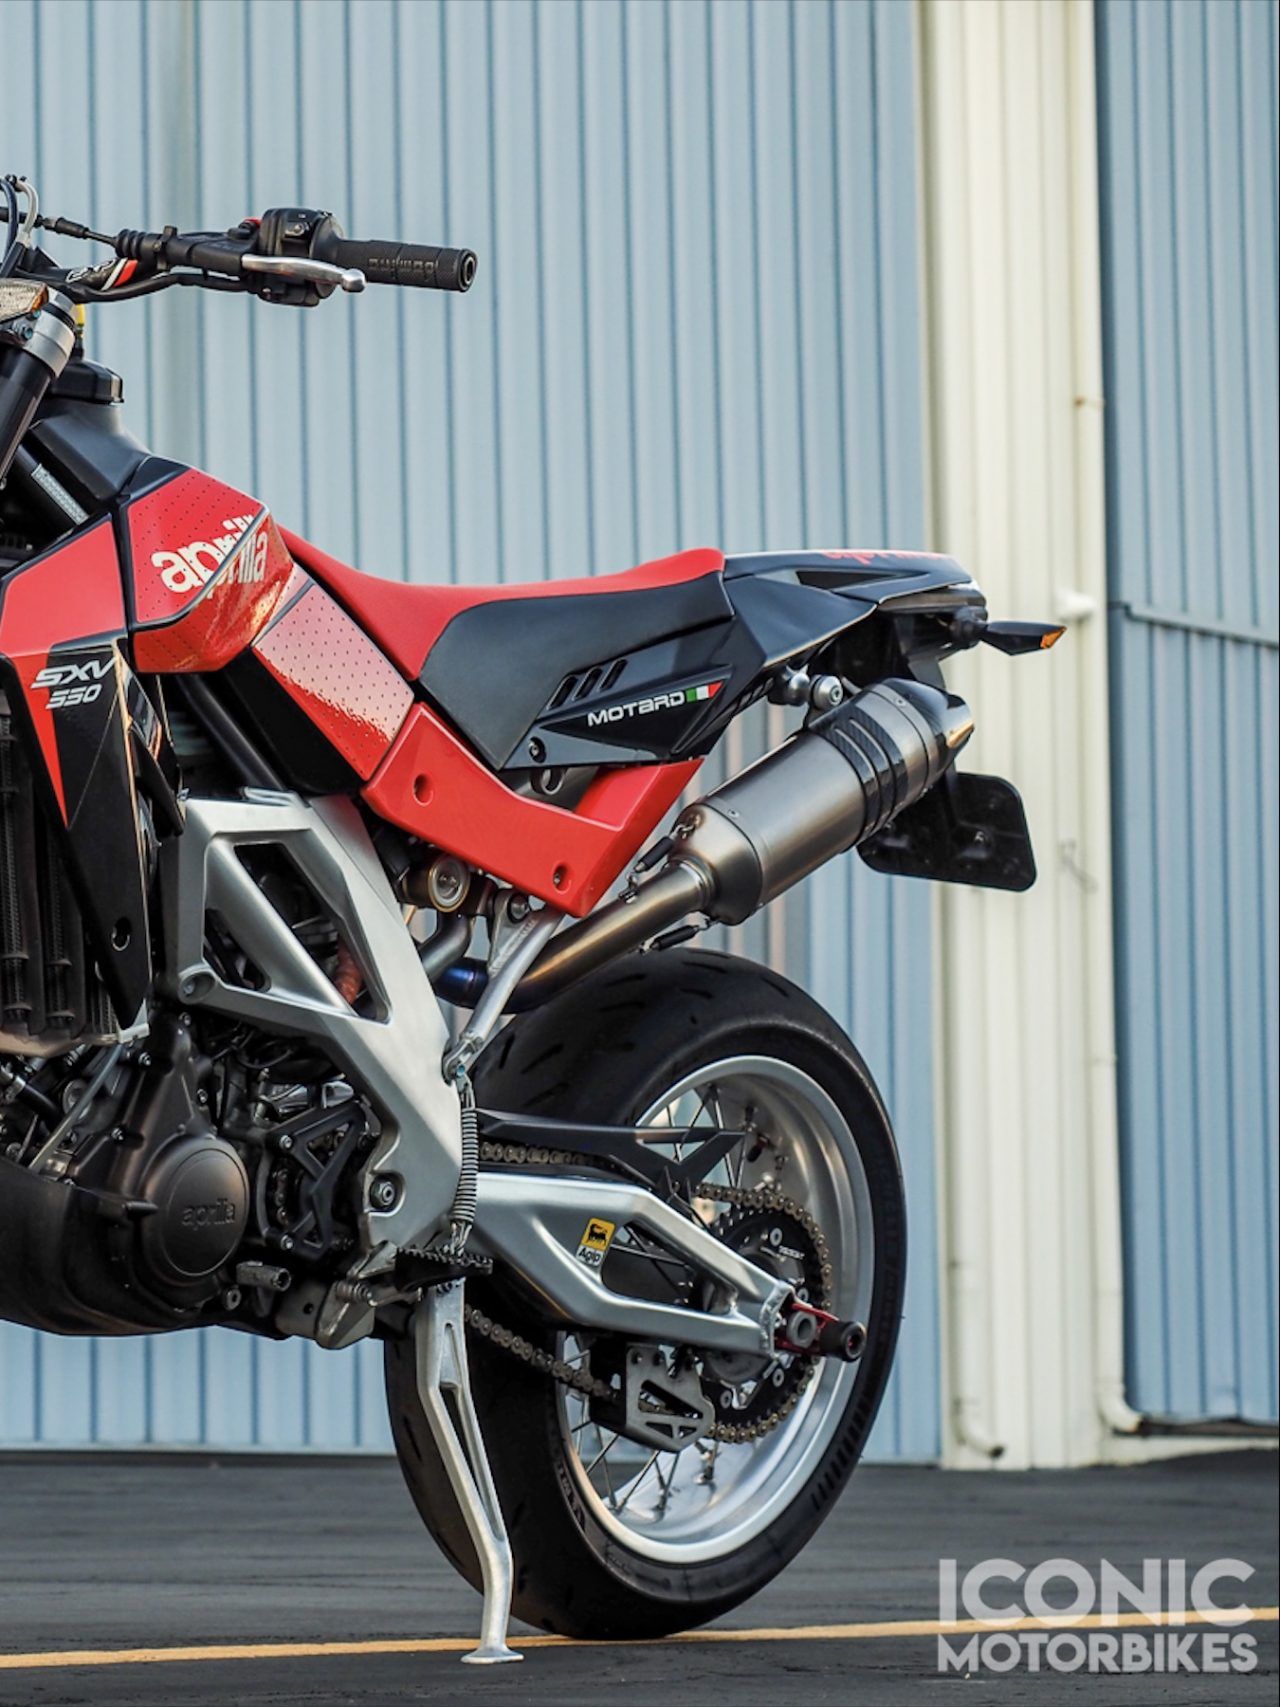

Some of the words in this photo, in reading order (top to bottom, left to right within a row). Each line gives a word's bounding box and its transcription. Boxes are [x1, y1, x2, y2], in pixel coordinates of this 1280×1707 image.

[151, 514, 268, 600] aprilia
[30, 656, 116, 689] SXV
[45, 683, 103, 710] 550
